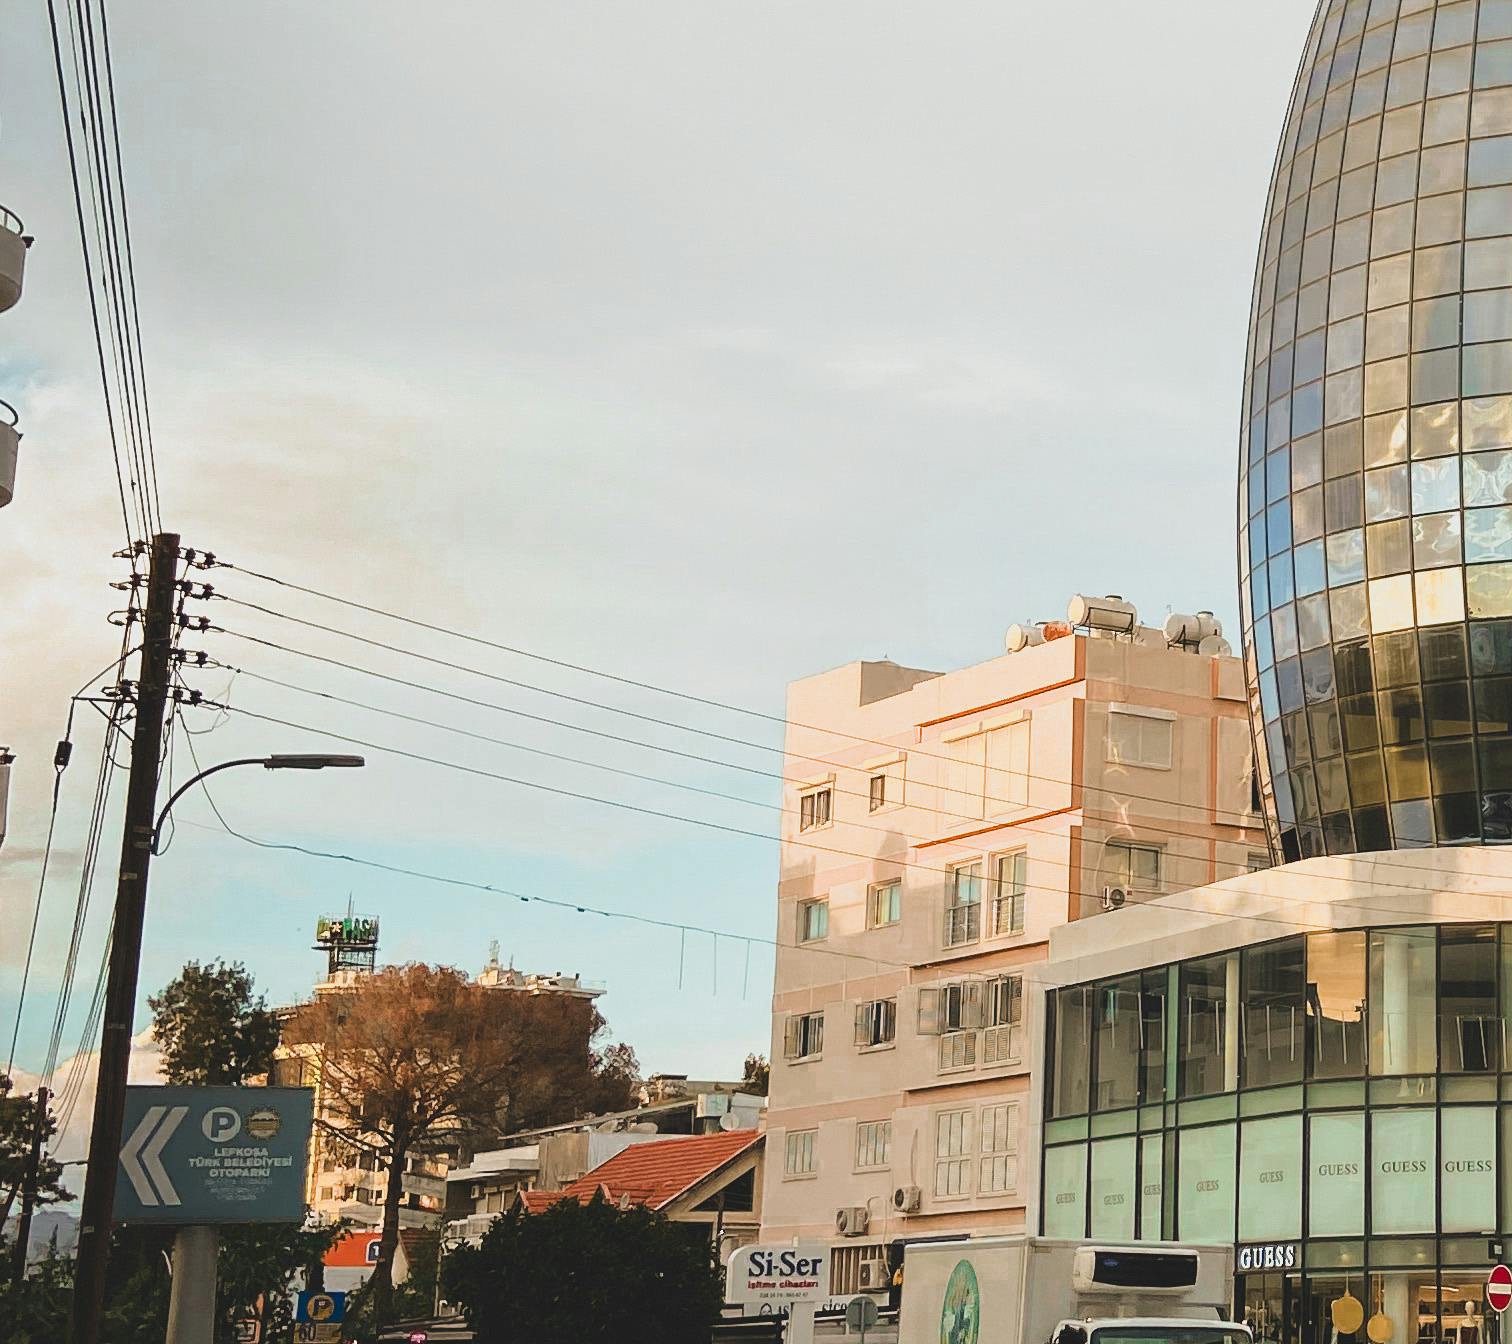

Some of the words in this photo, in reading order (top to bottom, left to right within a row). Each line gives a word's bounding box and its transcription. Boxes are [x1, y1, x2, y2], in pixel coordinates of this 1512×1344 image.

[188, 1156, 220, 1167] TÜRK
[1381, 1160, 1427, 1173] GUESS
[1445, 1160, 1493, 1173] GUESS
[1318, 1163, 1358, 1177] GUESS
[1259, 1170, 1284, 1184] GUESS
[1196, 1180, 1220, 1193] GUESS
[748, 1250, 823, 1277] Si-Ser
[1240, 1245, 1296, 1269] GUESS
